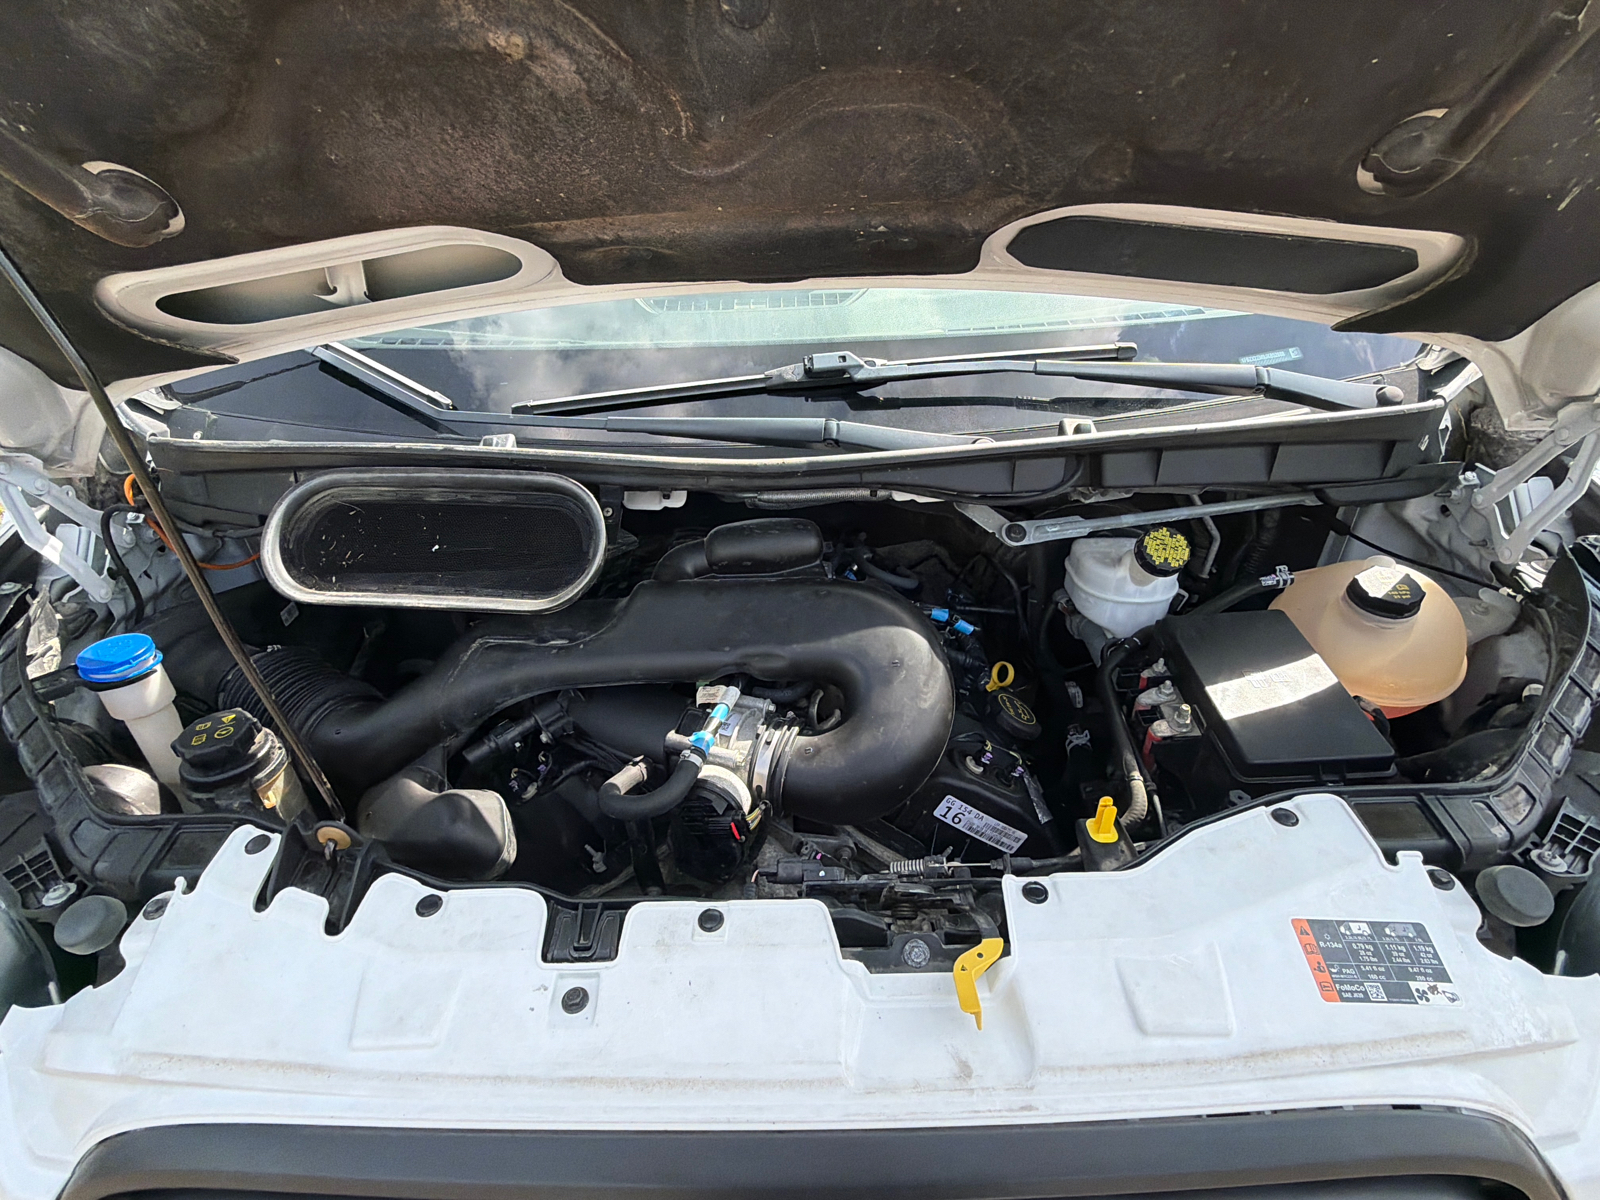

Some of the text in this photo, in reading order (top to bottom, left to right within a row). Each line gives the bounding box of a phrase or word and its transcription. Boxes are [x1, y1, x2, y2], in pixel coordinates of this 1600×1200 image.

[945, 797, 985, 822] GG 154 DA
[939, 805, 966, 825] 16
[1319, 941, 1343, 949] R-134a
[1364, 943, 1374, 951] kg
[1425, 945, 1434, 953] kg
[1335, 983, 1365, 991] FoMoCo
